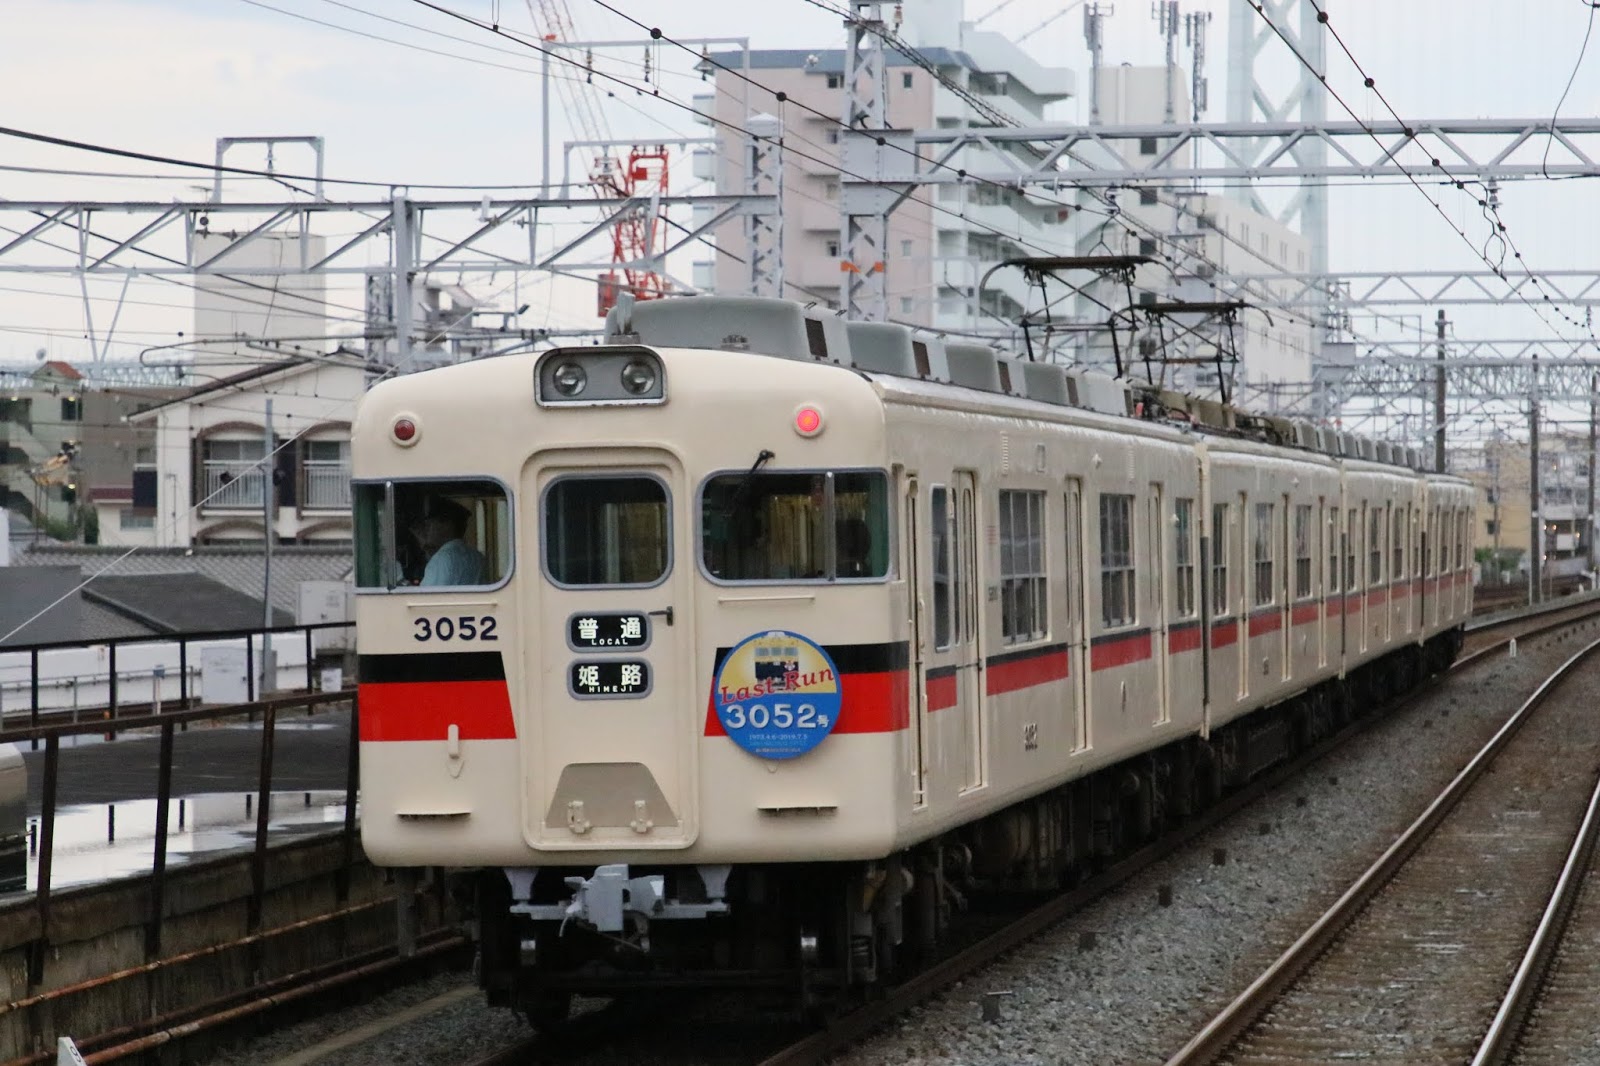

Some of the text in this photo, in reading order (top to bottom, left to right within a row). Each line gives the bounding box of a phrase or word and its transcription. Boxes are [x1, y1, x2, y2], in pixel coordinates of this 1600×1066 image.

[413, 616, 498, 642] 3052
[578, 617, 642, 639] 普通
[591, 638, 629, 646] LOCAL
[588, 685, 633, 693] HIMEJI
[720, 668, 835, 706] Last Run
